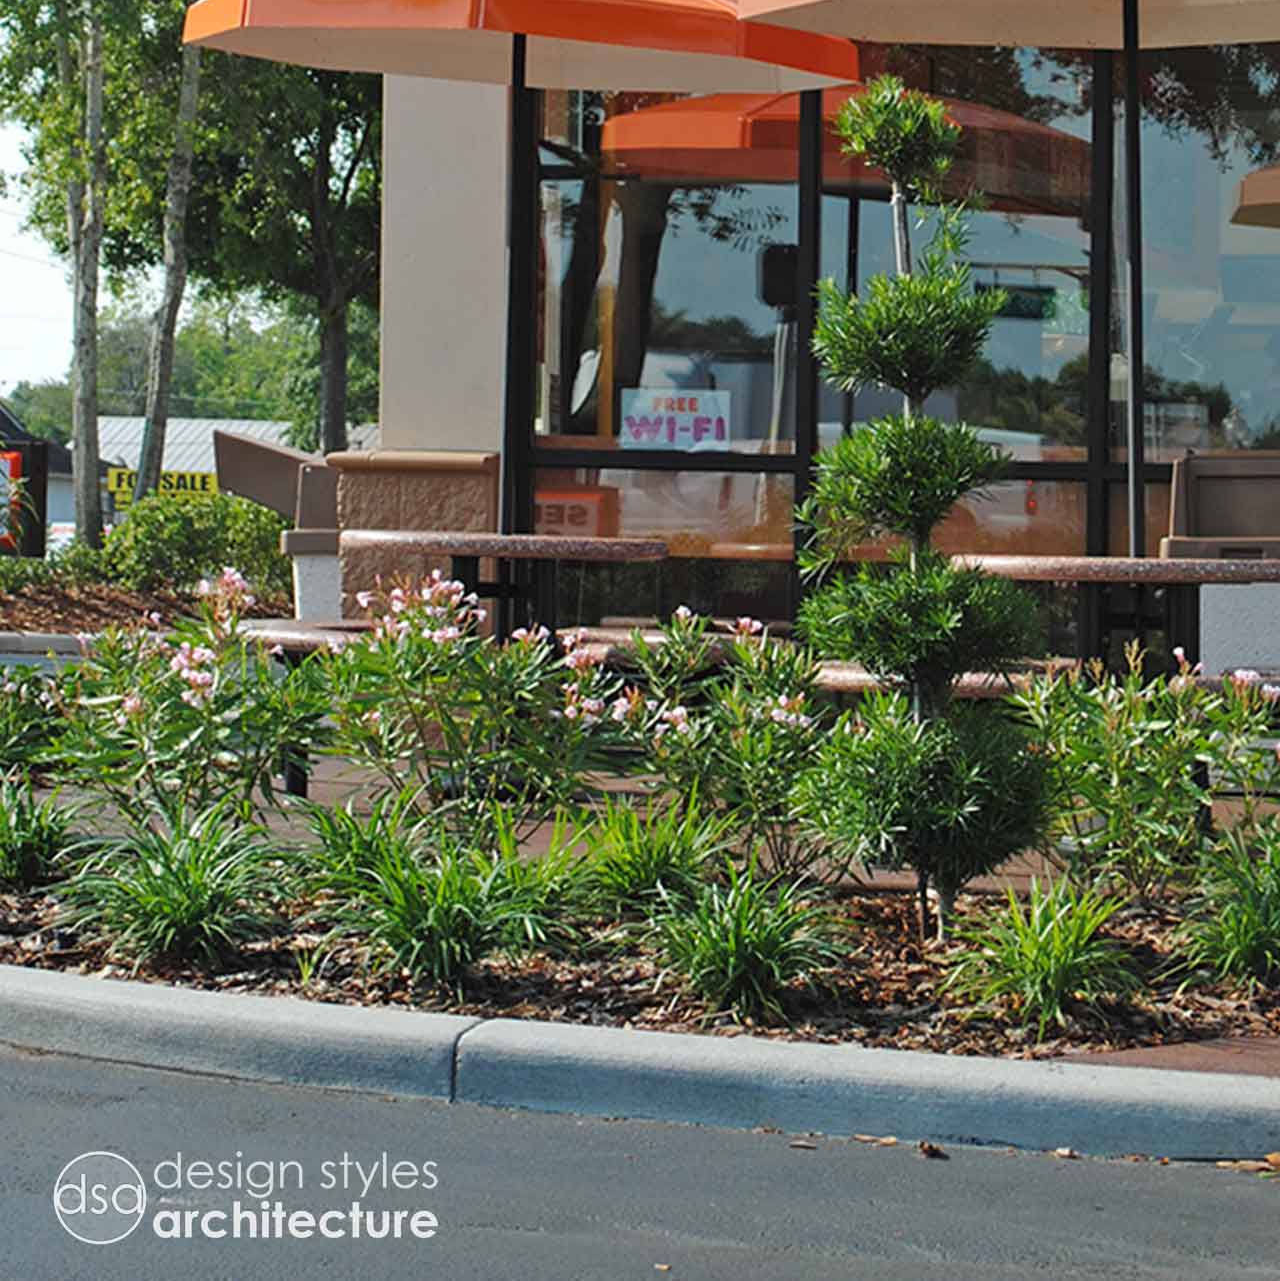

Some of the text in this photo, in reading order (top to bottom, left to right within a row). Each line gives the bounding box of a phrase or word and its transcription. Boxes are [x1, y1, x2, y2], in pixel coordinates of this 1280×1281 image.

[652, 397, 698, 414] FREE
[624, 415, 726, 443] WI-FI
[161, 472, 210, 491] SALE
